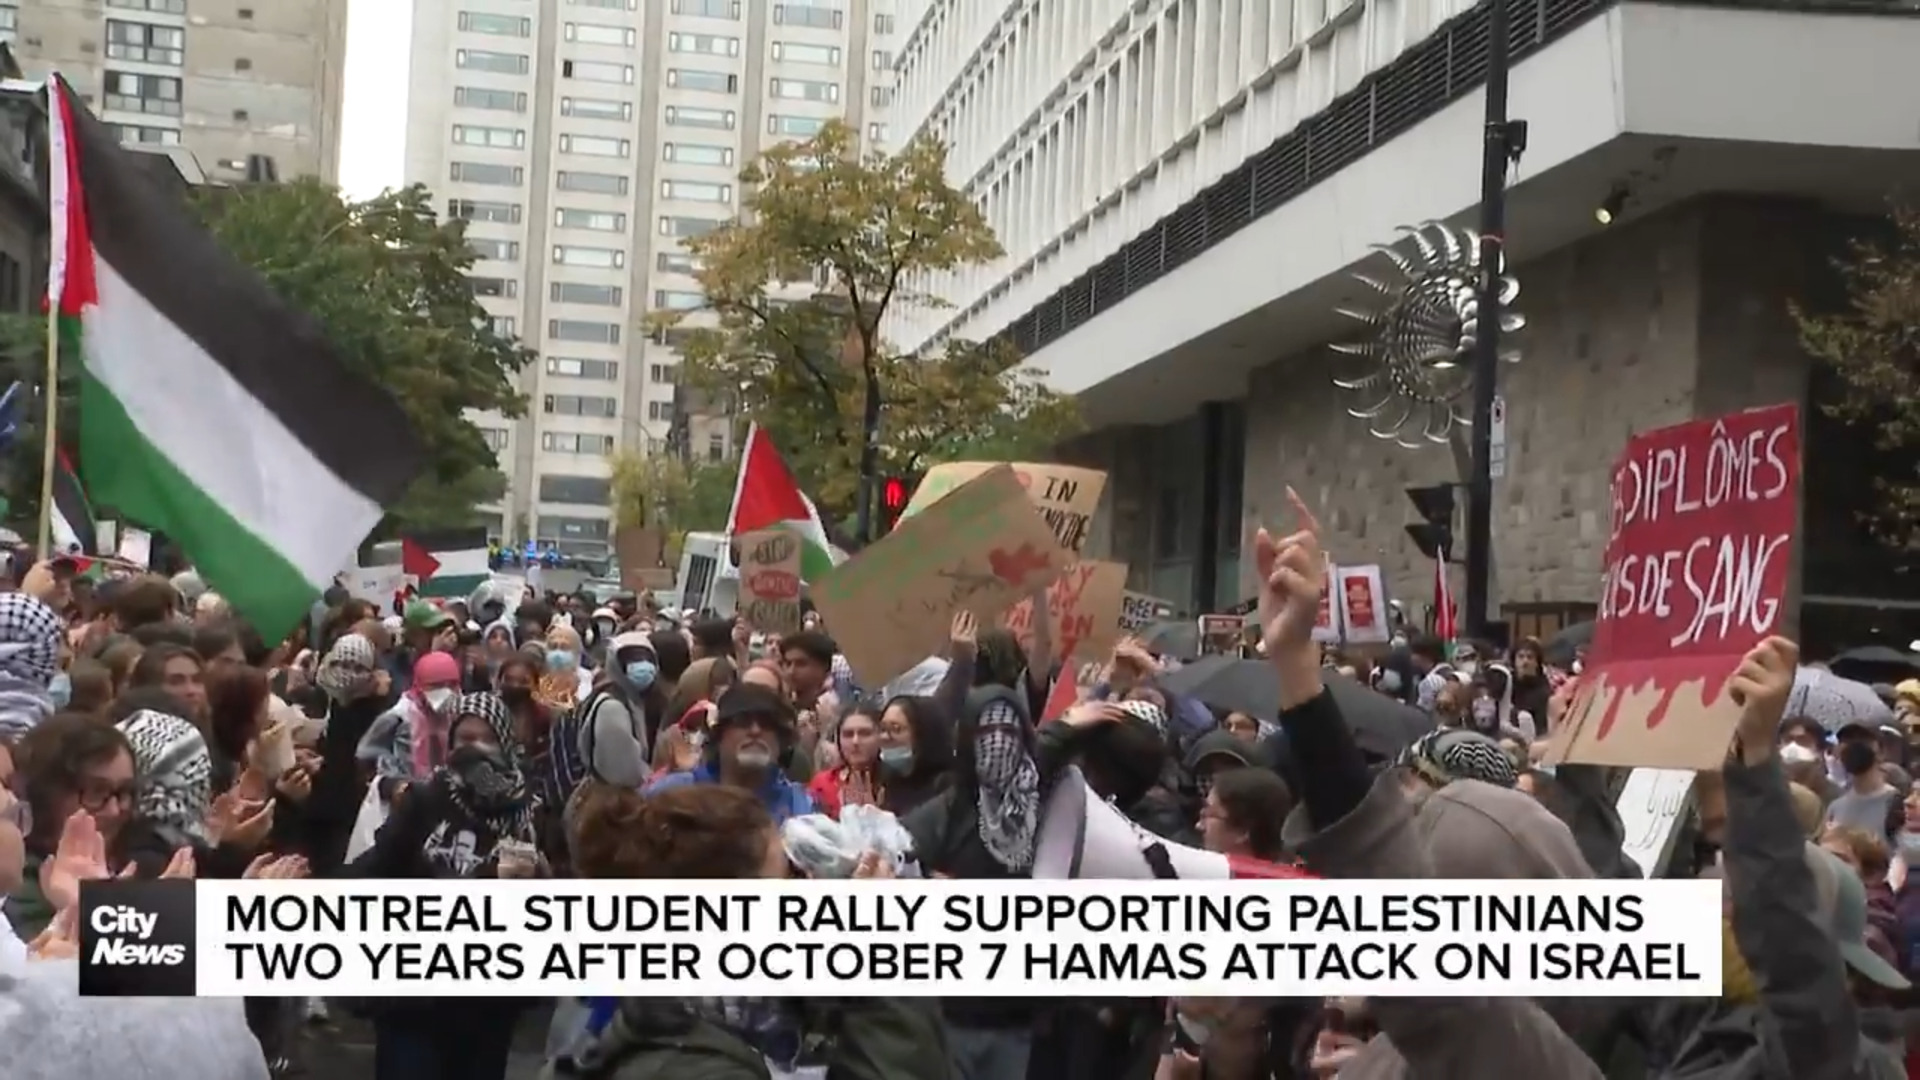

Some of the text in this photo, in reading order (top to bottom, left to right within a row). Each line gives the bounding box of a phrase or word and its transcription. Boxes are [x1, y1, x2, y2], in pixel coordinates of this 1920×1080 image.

[1041, 475, 1078, 503] IN
[1638, 550, 1682, 618] DE
[1671, 533, 1790, 649] SANG
